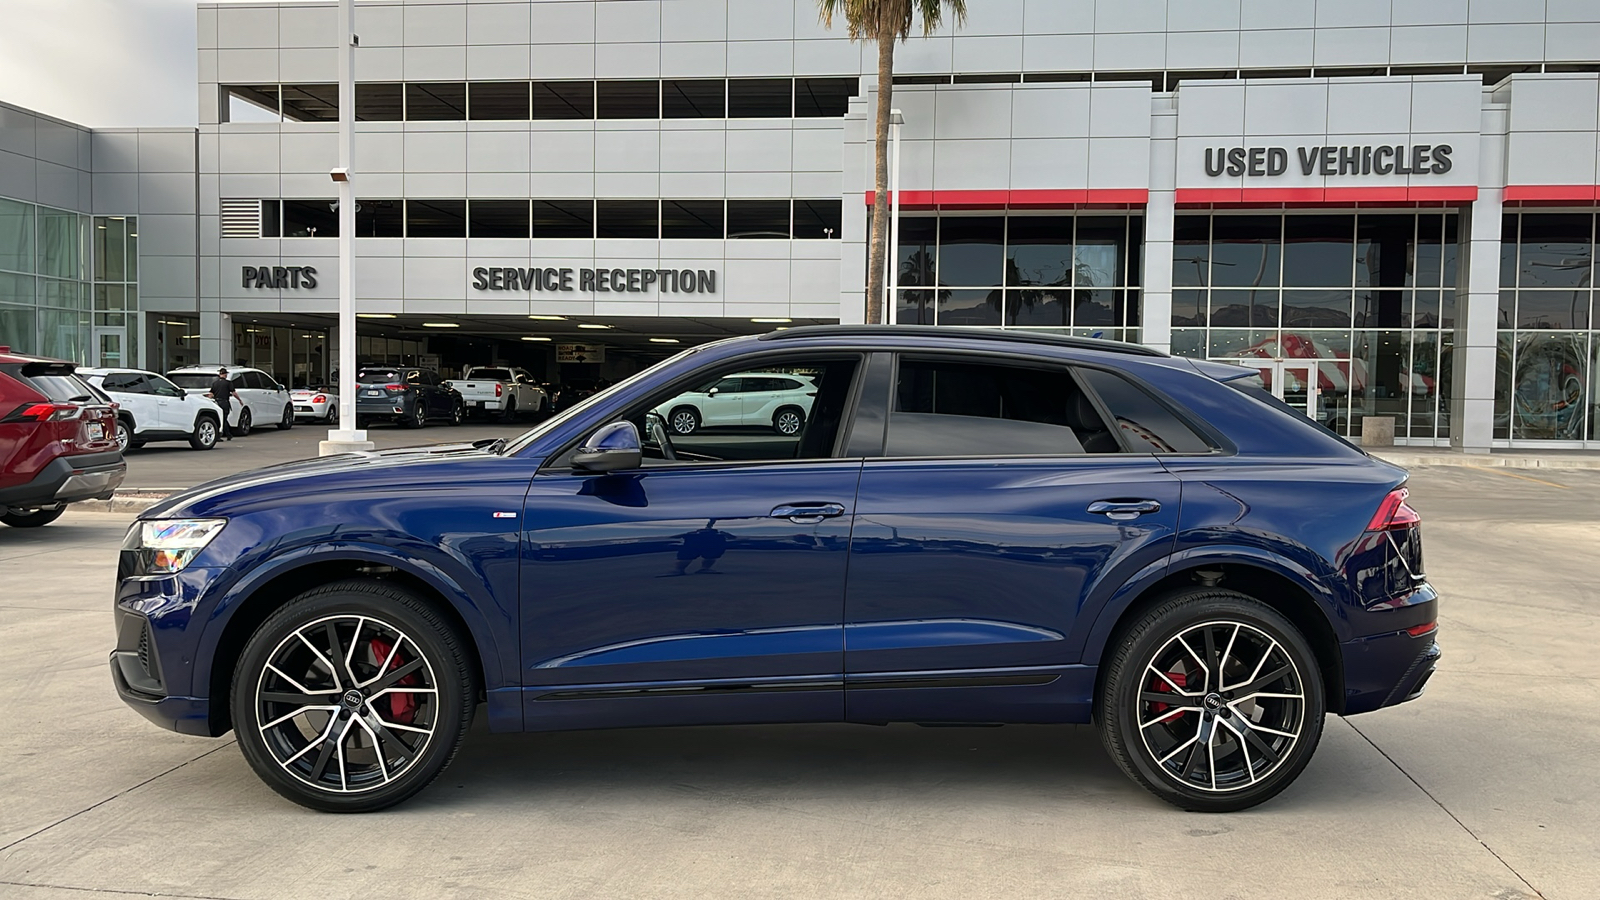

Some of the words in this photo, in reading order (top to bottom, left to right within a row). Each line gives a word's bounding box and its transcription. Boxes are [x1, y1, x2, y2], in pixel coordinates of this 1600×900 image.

[1205, 147, 1288, 177] USED
[1297, 145, 1453, 175] VEHICLES
[242, 266, 317, 289] PARTS
[472, 267, 573, 291] SERVICE
[579, 268, 716, 293] RECEPTION
[249, 334, 278, 346] OYOA
